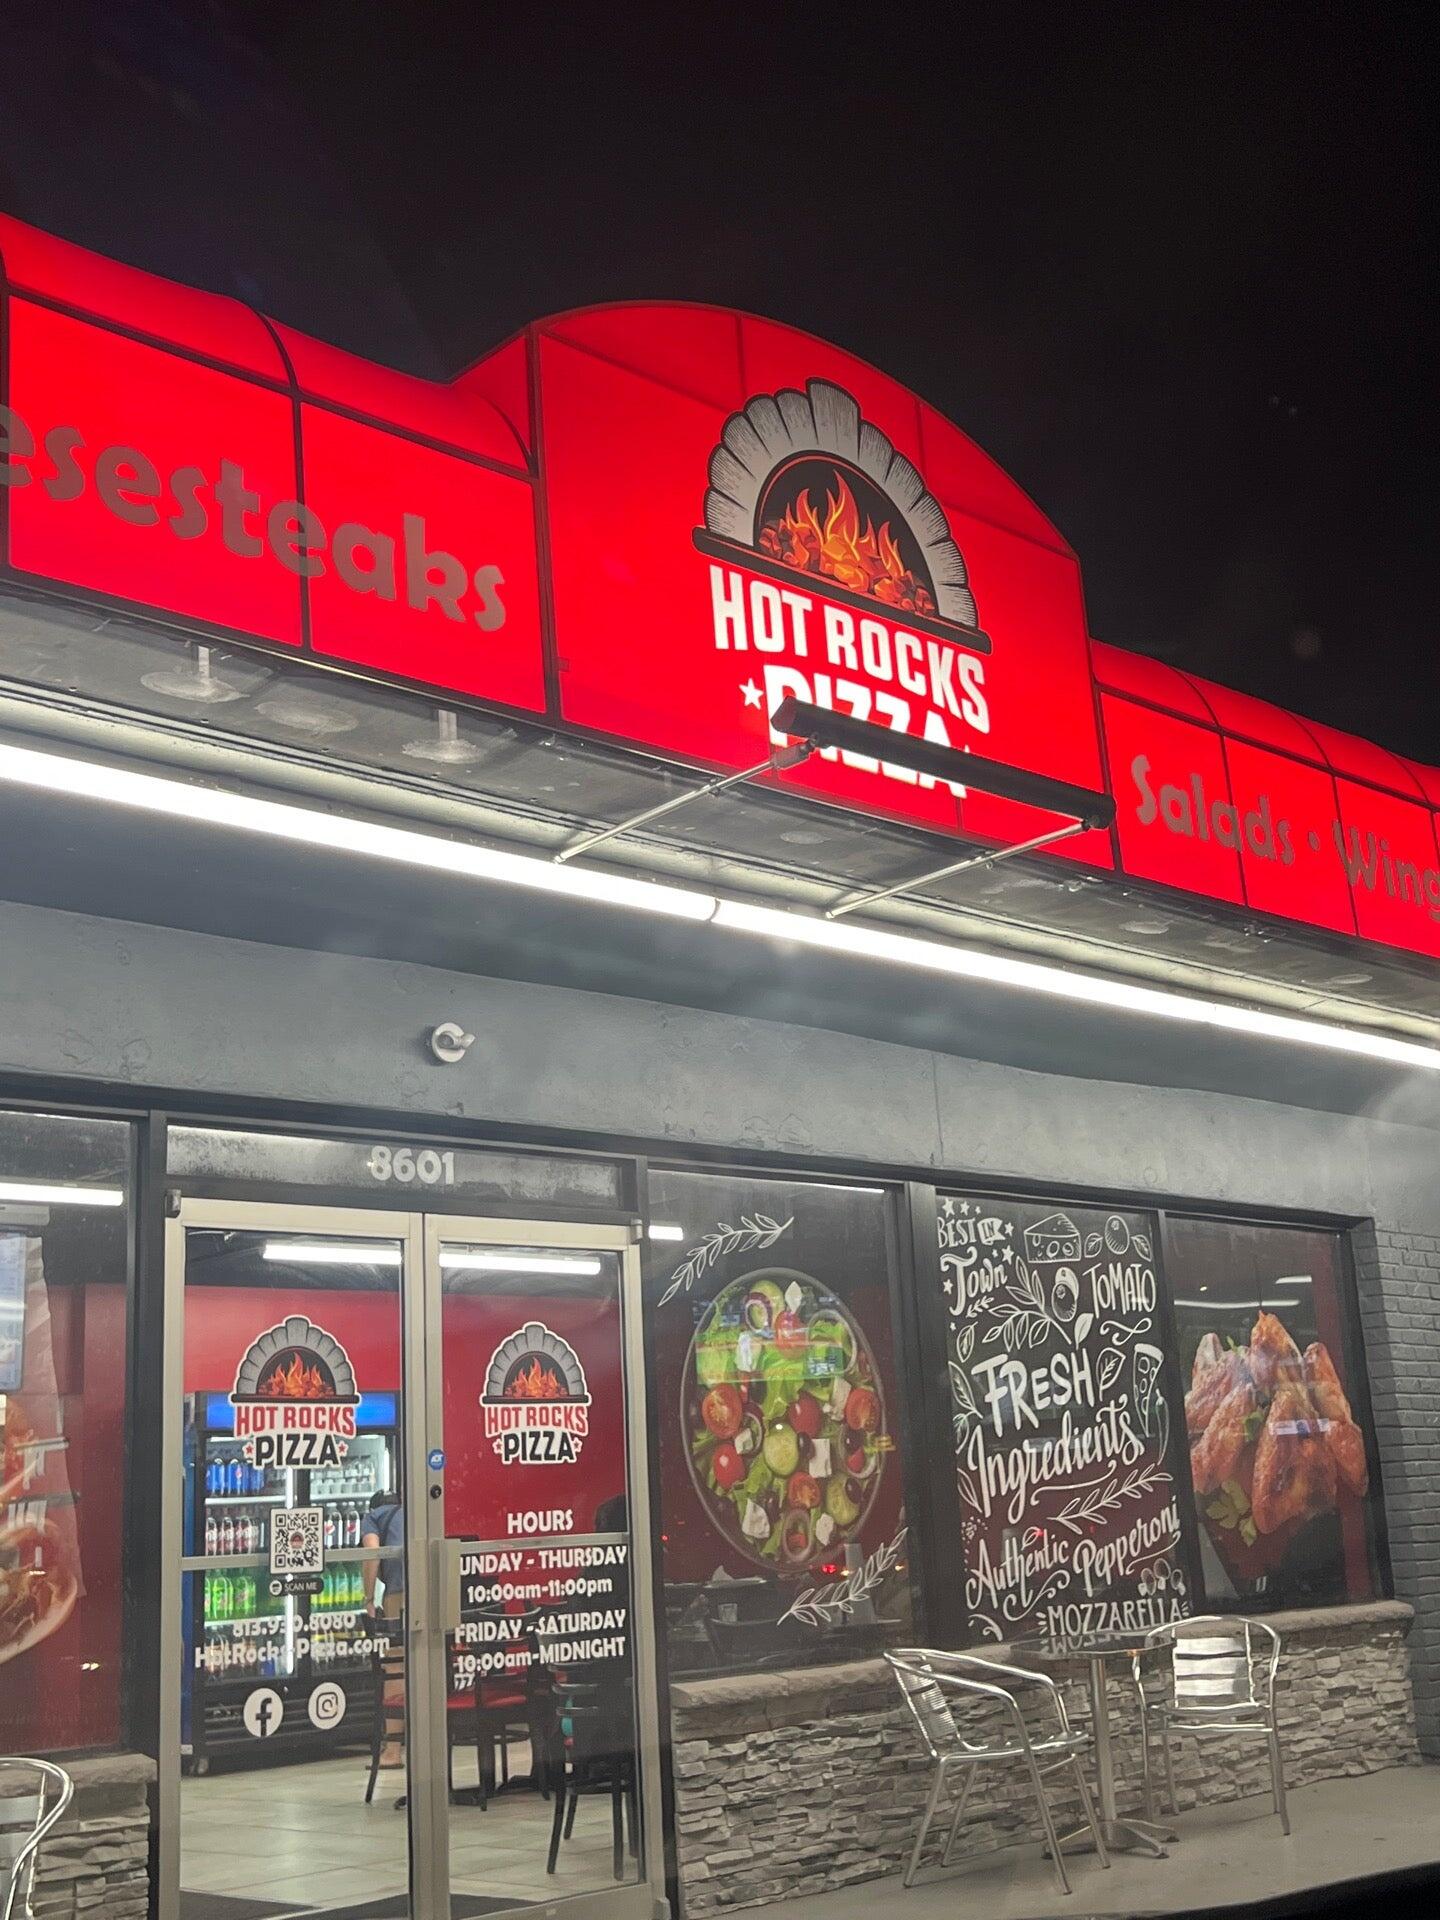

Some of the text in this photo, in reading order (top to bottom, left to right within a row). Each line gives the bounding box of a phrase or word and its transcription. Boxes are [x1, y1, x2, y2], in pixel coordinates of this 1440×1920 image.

[709, 565, 990, 734] HOT ROCKS
[1131, 754, 1295, 865] Salads
[371, 1145, 455, 1184] 8601
[937, 1217, 977, 1248] BEST
[940, 1246, 1008, 1316] Town
[971, 1348, 1094, 1437] FRESH
[236, 1406, 355, 1437] HOT ROCKS
[487, 1405, 588, 1436] HOT ROCKS
[255, 1433, 340, 1466] PIZZA
[503, 1431, 575, 1462] PIZZA
[967, 1394, 1145, 1524] Ingredients
[507, 1509, 573, 1534] HOURS
[460, 1552, 523, 1576] UNDAY
[538, 1545, 627, 1569] THURSDAY
[966, 1495, 1181, 1609] Authentic Pepperoni
[455, 1619, 522, 1644] FRIDAY
[538, 1609, 627, 1635] SATURDAY
[1047, 1598, 1182, 1636] MOZZARELLA
